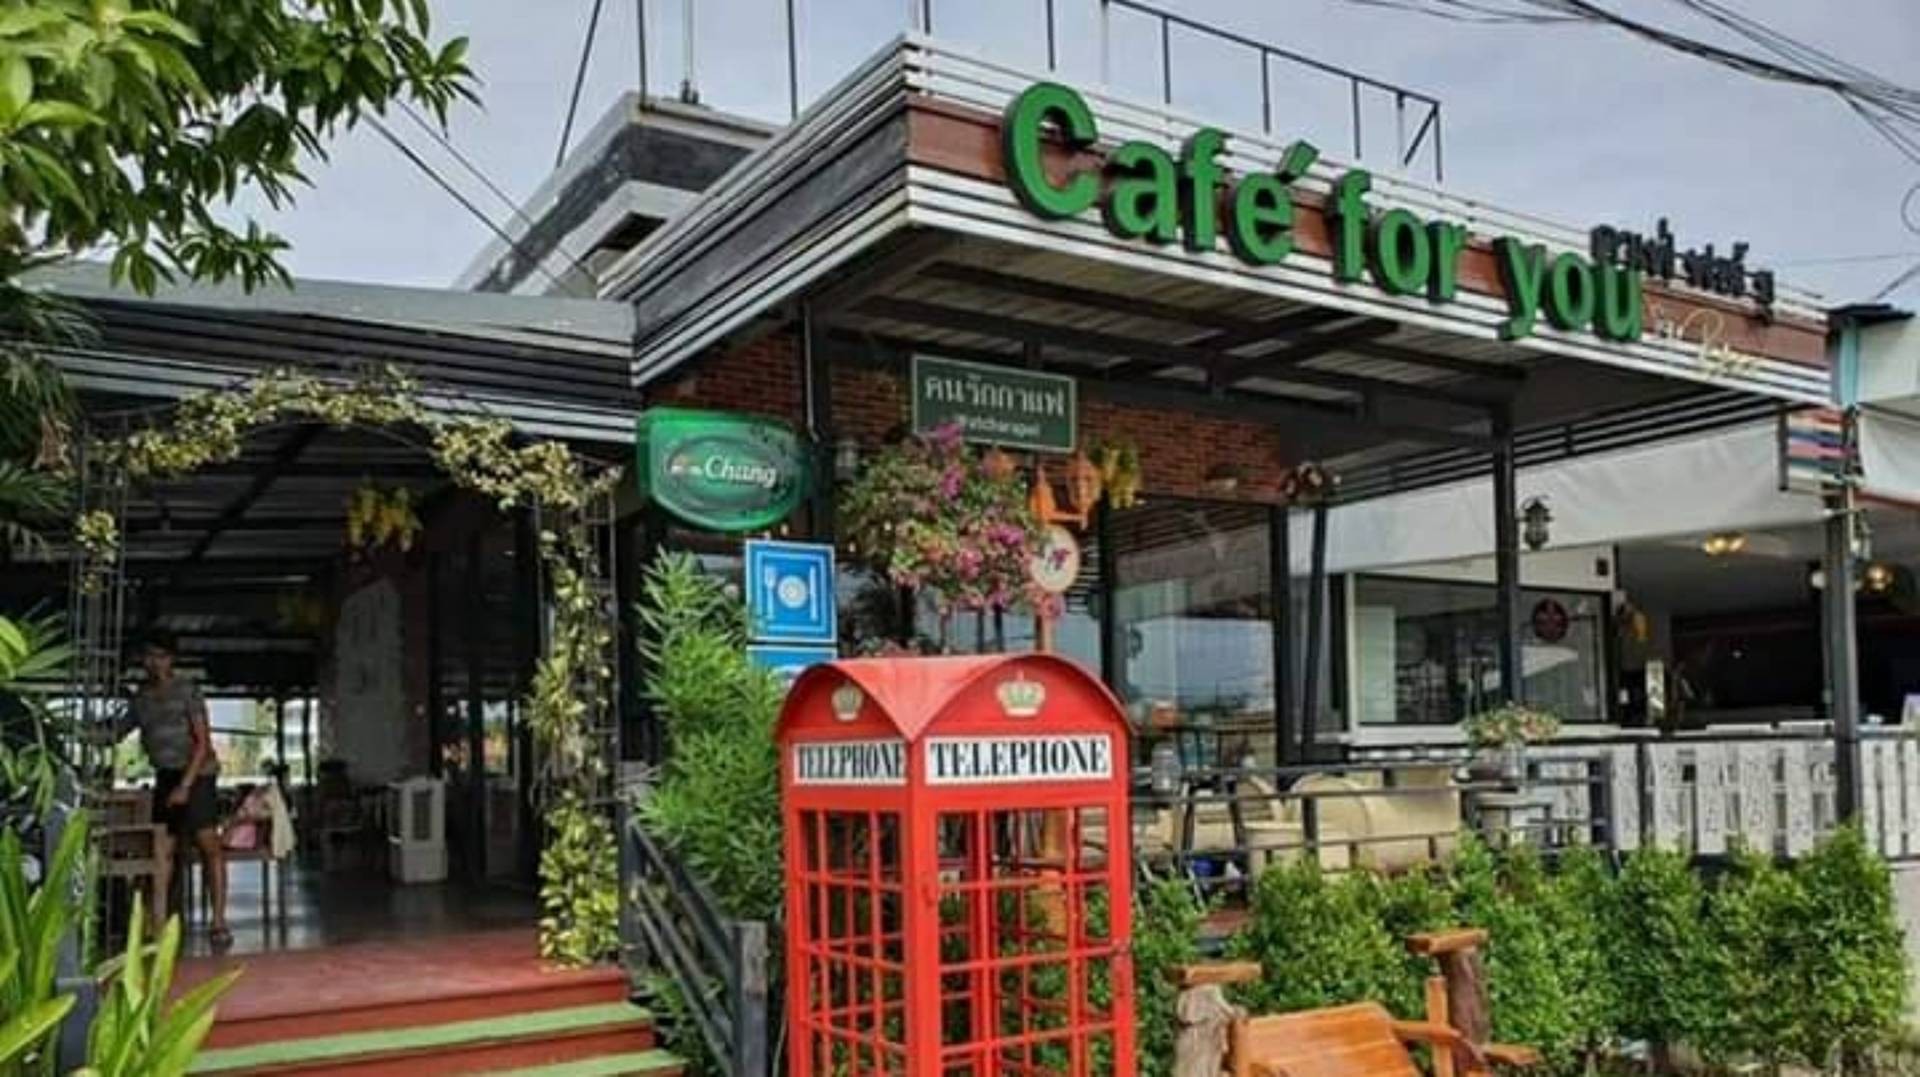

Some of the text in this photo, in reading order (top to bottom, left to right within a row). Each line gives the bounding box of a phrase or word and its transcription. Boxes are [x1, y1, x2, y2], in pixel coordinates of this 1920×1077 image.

[1005, 82, 1319, 266] Café
[1332, 170, 1466, 303] for
[1496, 236, 1641, 341] you
[706, 455, 776, 488] Chang
[799, 743, 906, 779] TELEPHONE
[930, 738, 1107, 778] TELEPHONE
